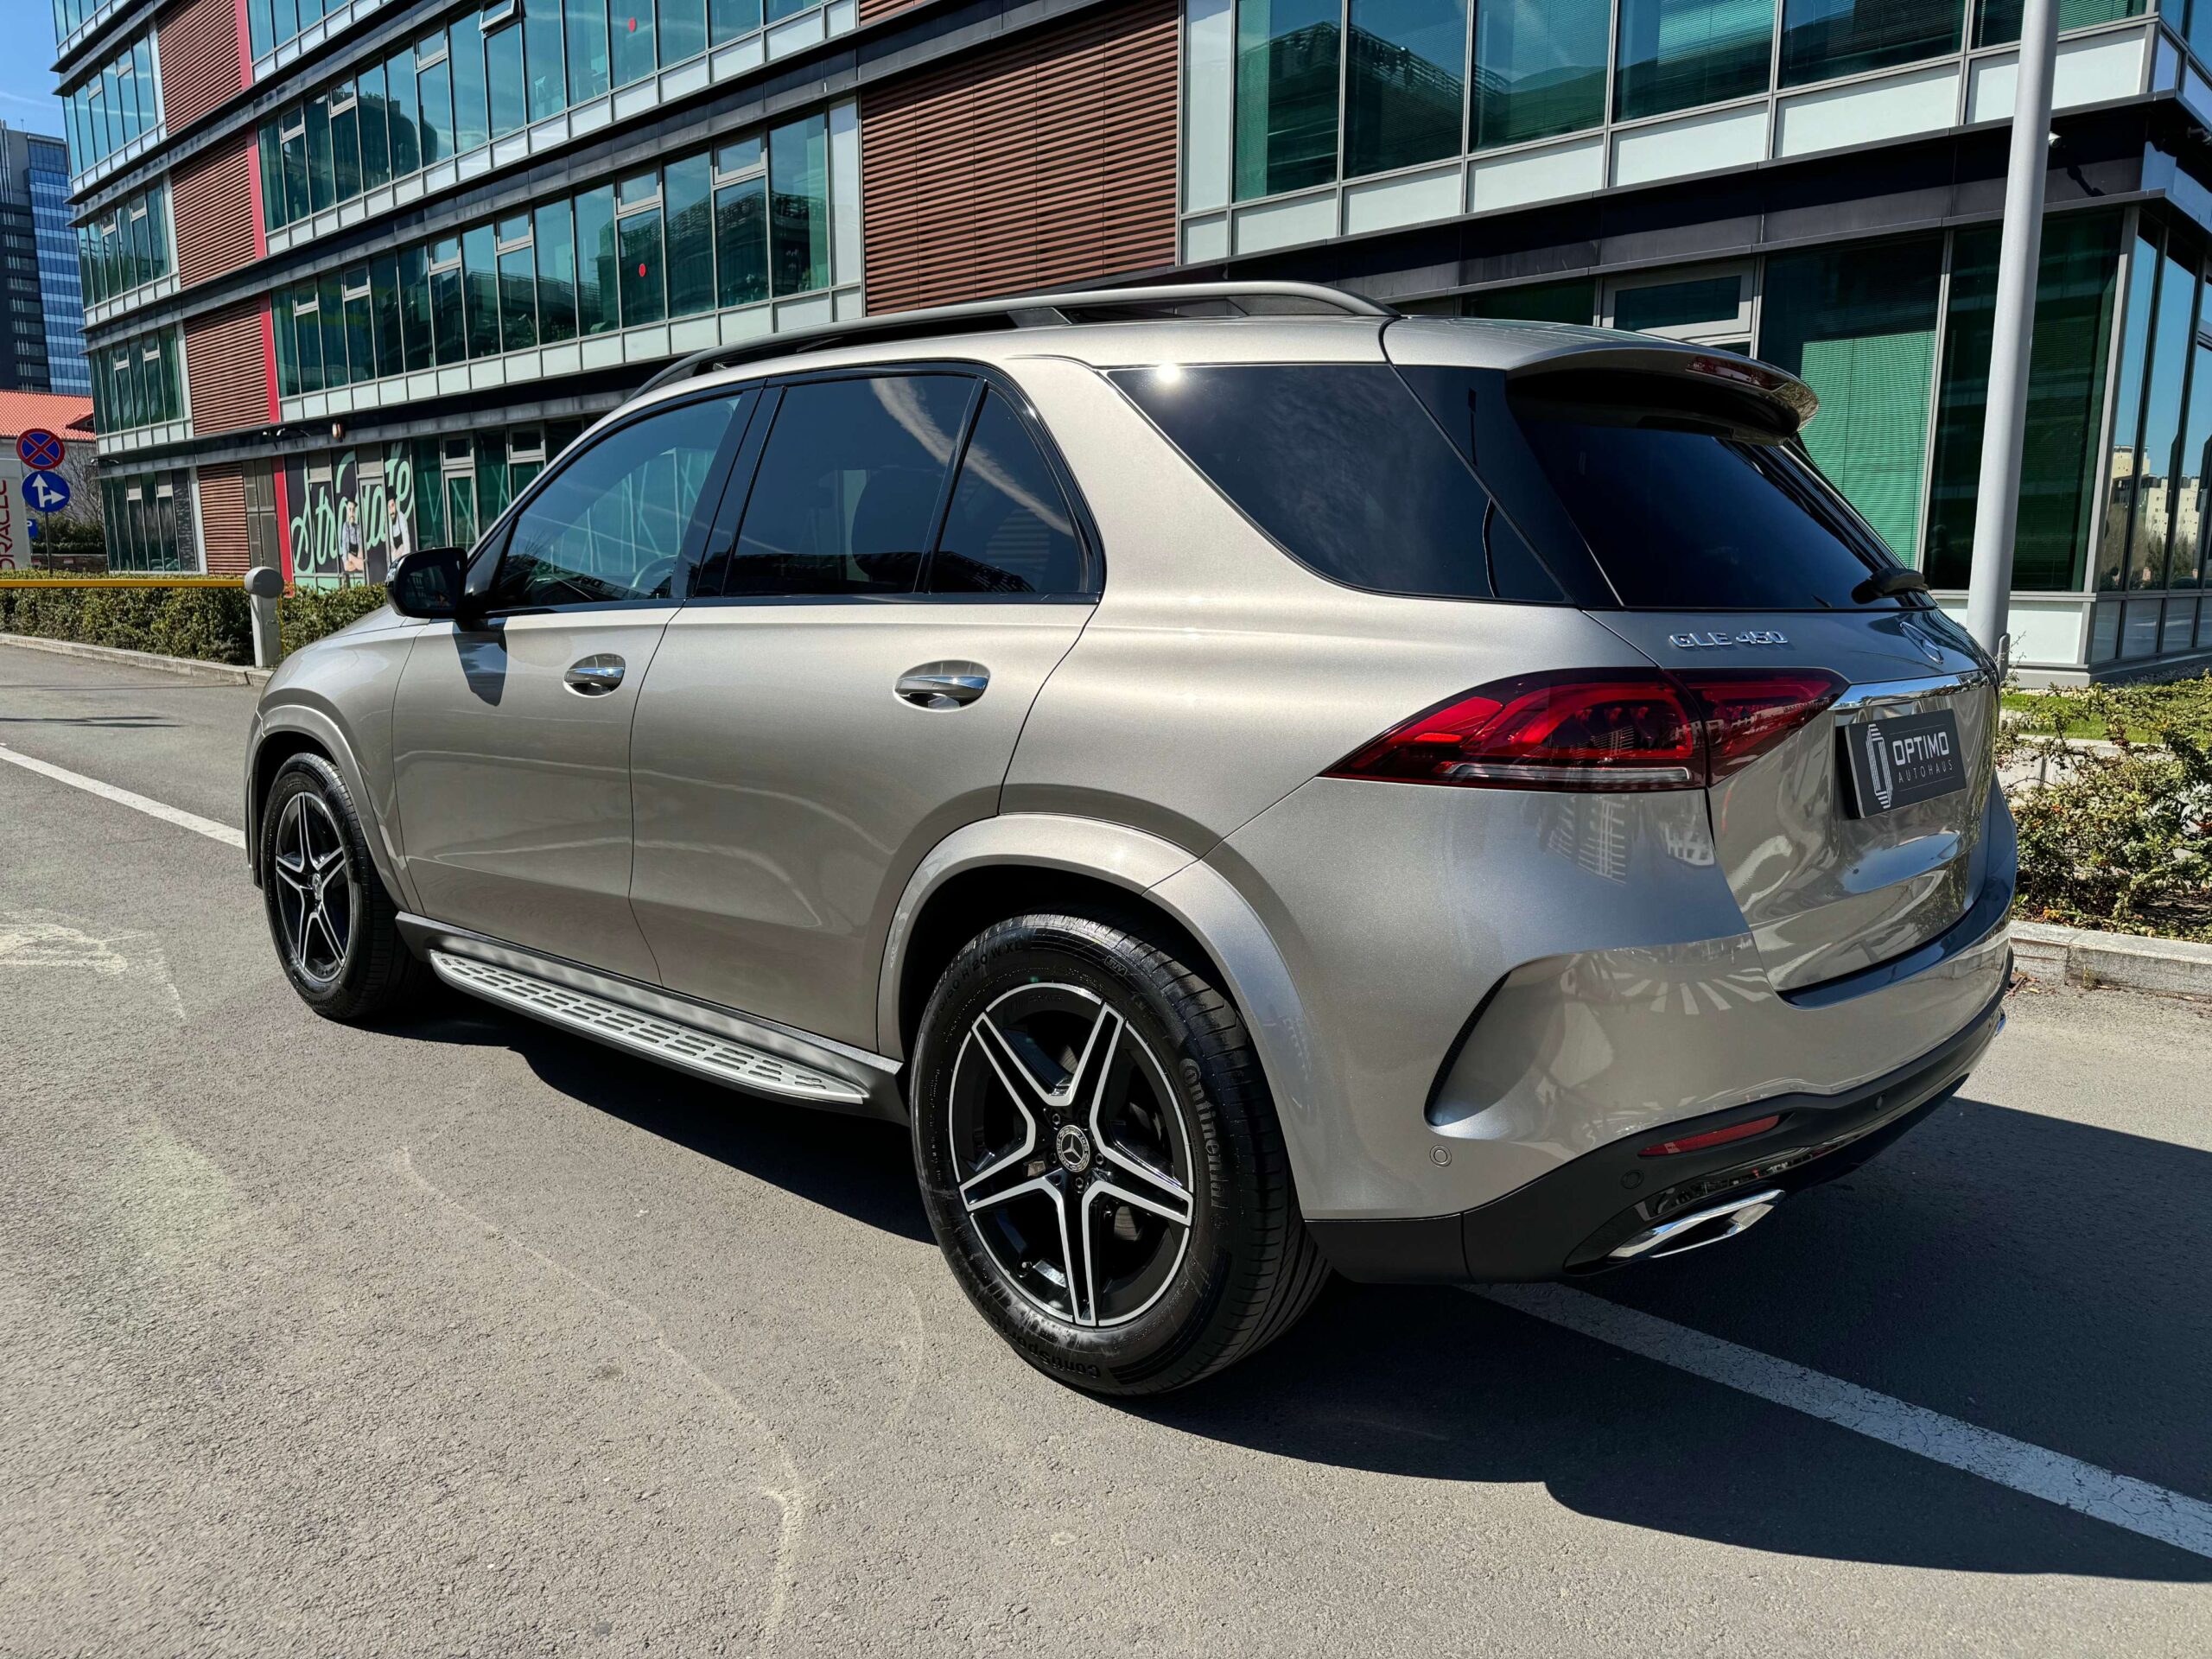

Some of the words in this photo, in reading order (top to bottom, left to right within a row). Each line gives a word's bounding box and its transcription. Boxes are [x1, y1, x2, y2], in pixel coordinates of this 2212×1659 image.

[1669, 632, 1733, 647] GLE
[1735, 631, 1789, 645] 450
[1892, 731, 1950, 766] OPTIMO
[1897, 759, 1954, 785] AUTOHAUS
[1106, 958, 1125, 972] SUV
[1178, 1058, 1230, 1211] Continental
